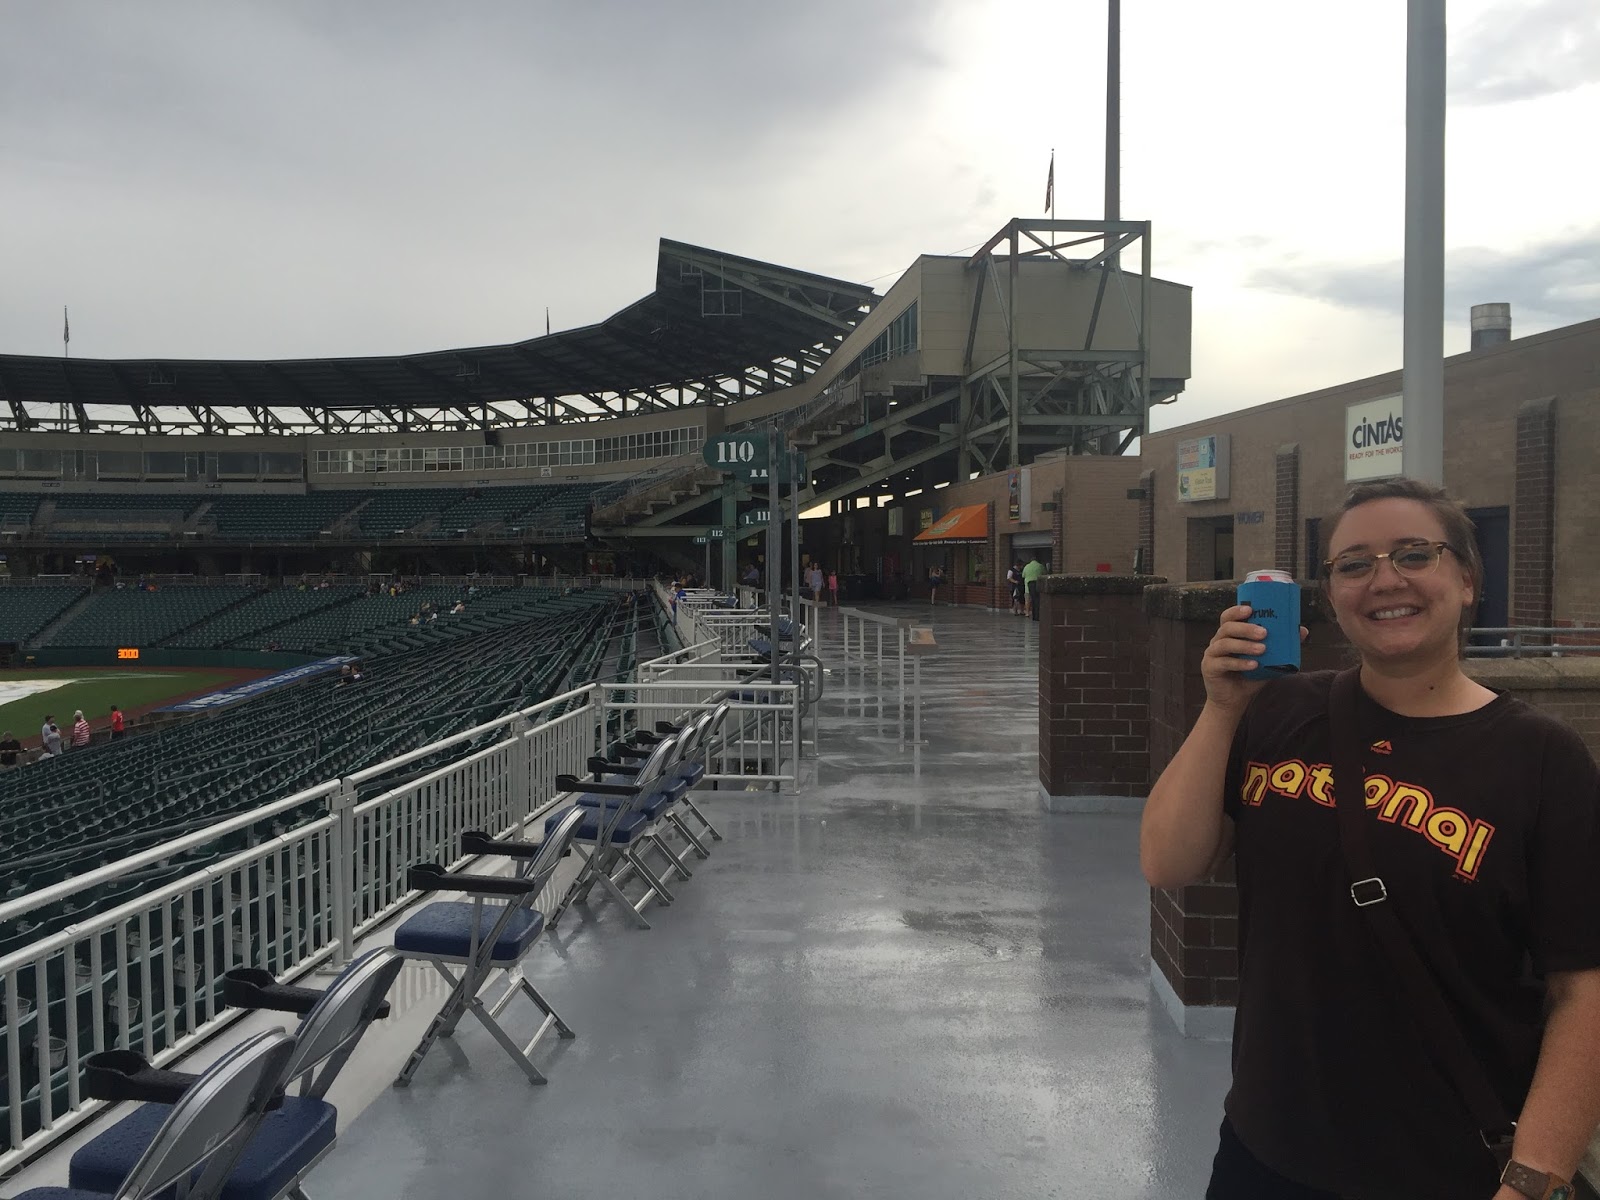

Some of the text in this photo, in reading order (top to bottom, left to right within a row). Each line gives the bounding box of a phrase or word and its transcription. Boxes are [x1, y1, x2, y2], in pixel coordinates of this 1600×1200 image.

[717, 441, 754, 463] 110
[1349, 452, 1364, 460] READY
[1365, 450, 1374, 458] FOR
[1375, 448, 1384, 456] THE
[712, 529, 724, 537] 112
[1252, 608, 1278, 619] runk,
[1241, 758, 1495, 881] natonal
